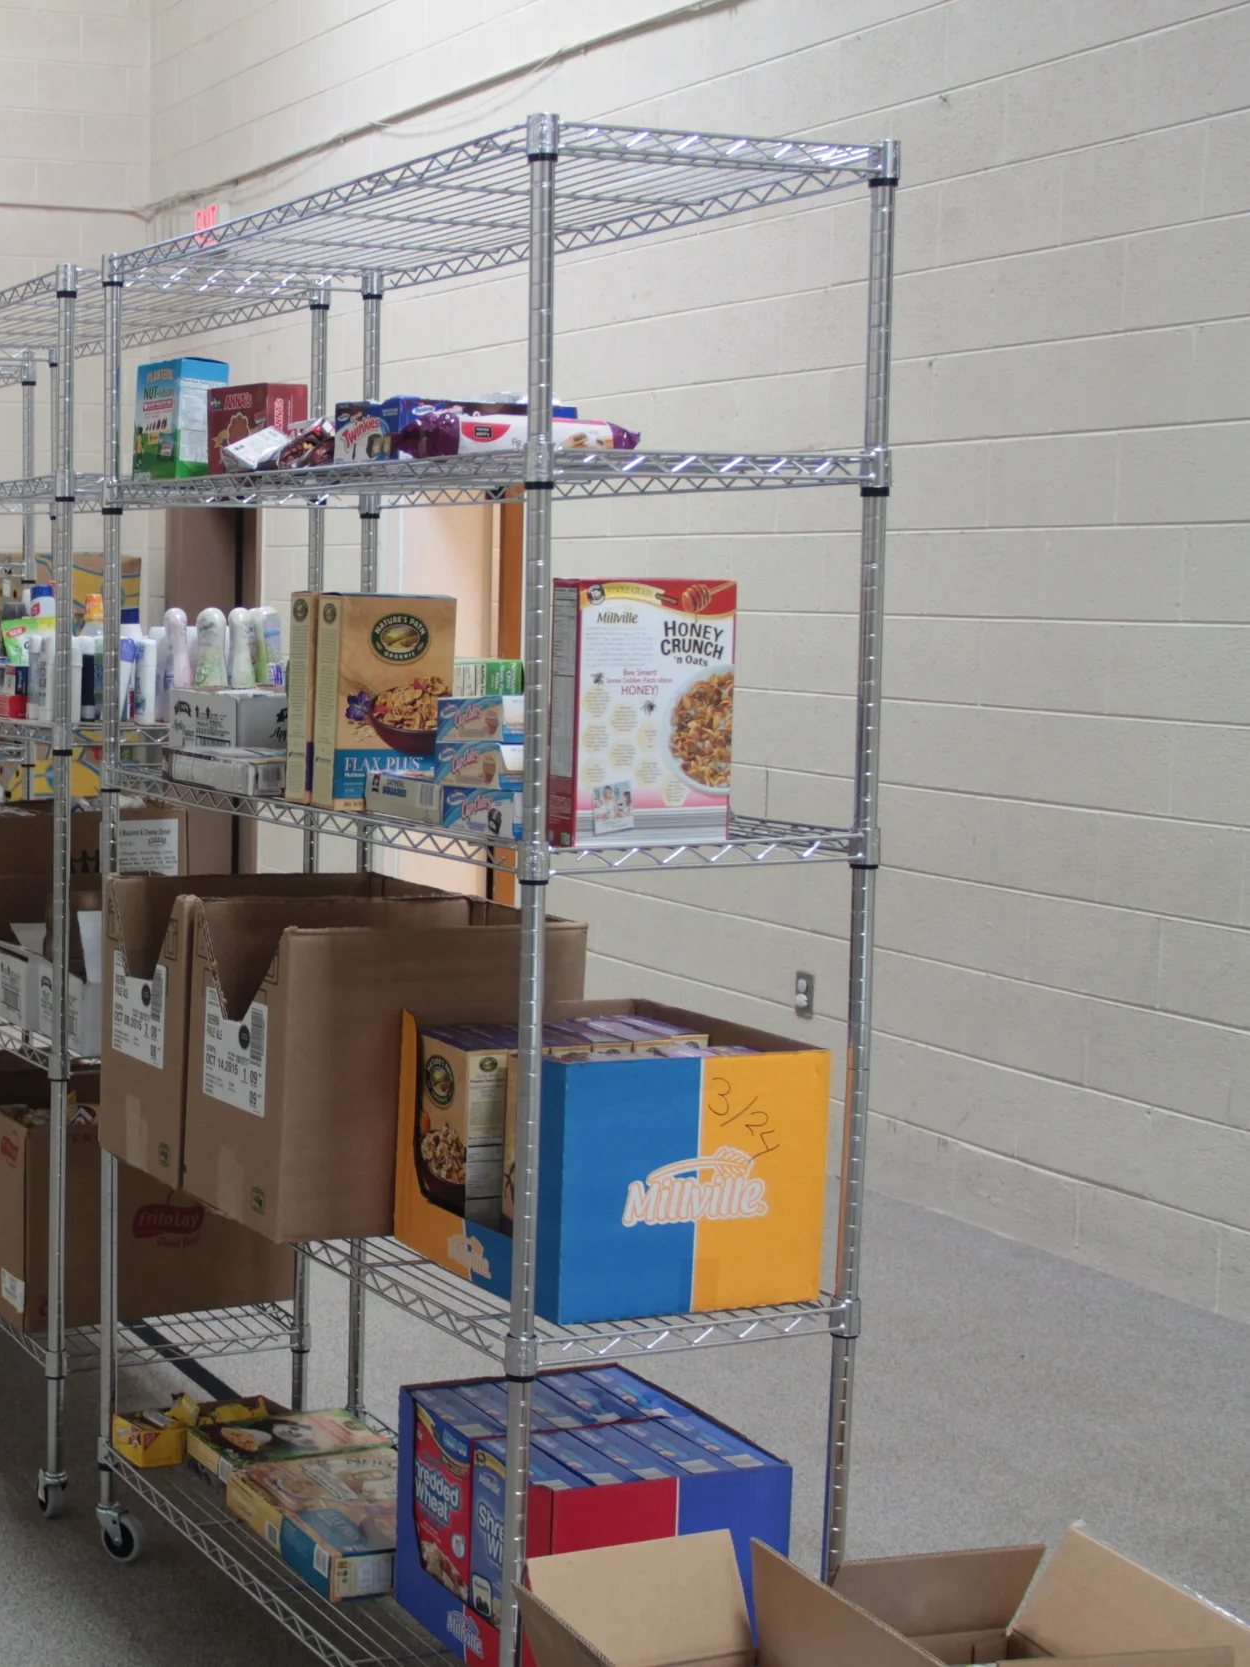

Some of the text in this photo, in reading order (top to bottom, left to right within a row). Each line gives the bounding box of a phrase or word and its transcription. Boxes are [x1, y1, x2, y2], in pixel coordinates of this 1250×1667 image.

[341, 415, 379, 452] Twinkies
[512, 438, 522, 449] Fig
[597, 611, 638, 624] Millville
[8, 627, 23, 637] NEW
[374, 615, 426, 636] NATURE'S PATH
[663, 620, 724, 642] HONEY
[383, 650, 416, 660] ORGANIC
[661, 639, 724, 661] CRUNCH
[685, 656, 709, 667] Oats
[621, 685, 659, 696] HONEY!
[270, 728, 287, 742] App
[344, 757, 420, 772] FLAX PLUS
[114, 1010, 123, 1024] OCT
[206, 1053, 216, 1067] OCT
[622, 1173, 767, 1227] Millville
[416, 1461, 459, 1507] hredded
[415, 1480, 450, 1522] Wheat
[478, 1506, 505, 1540] Shre
[446, 1613, 484, 1659] Millville
